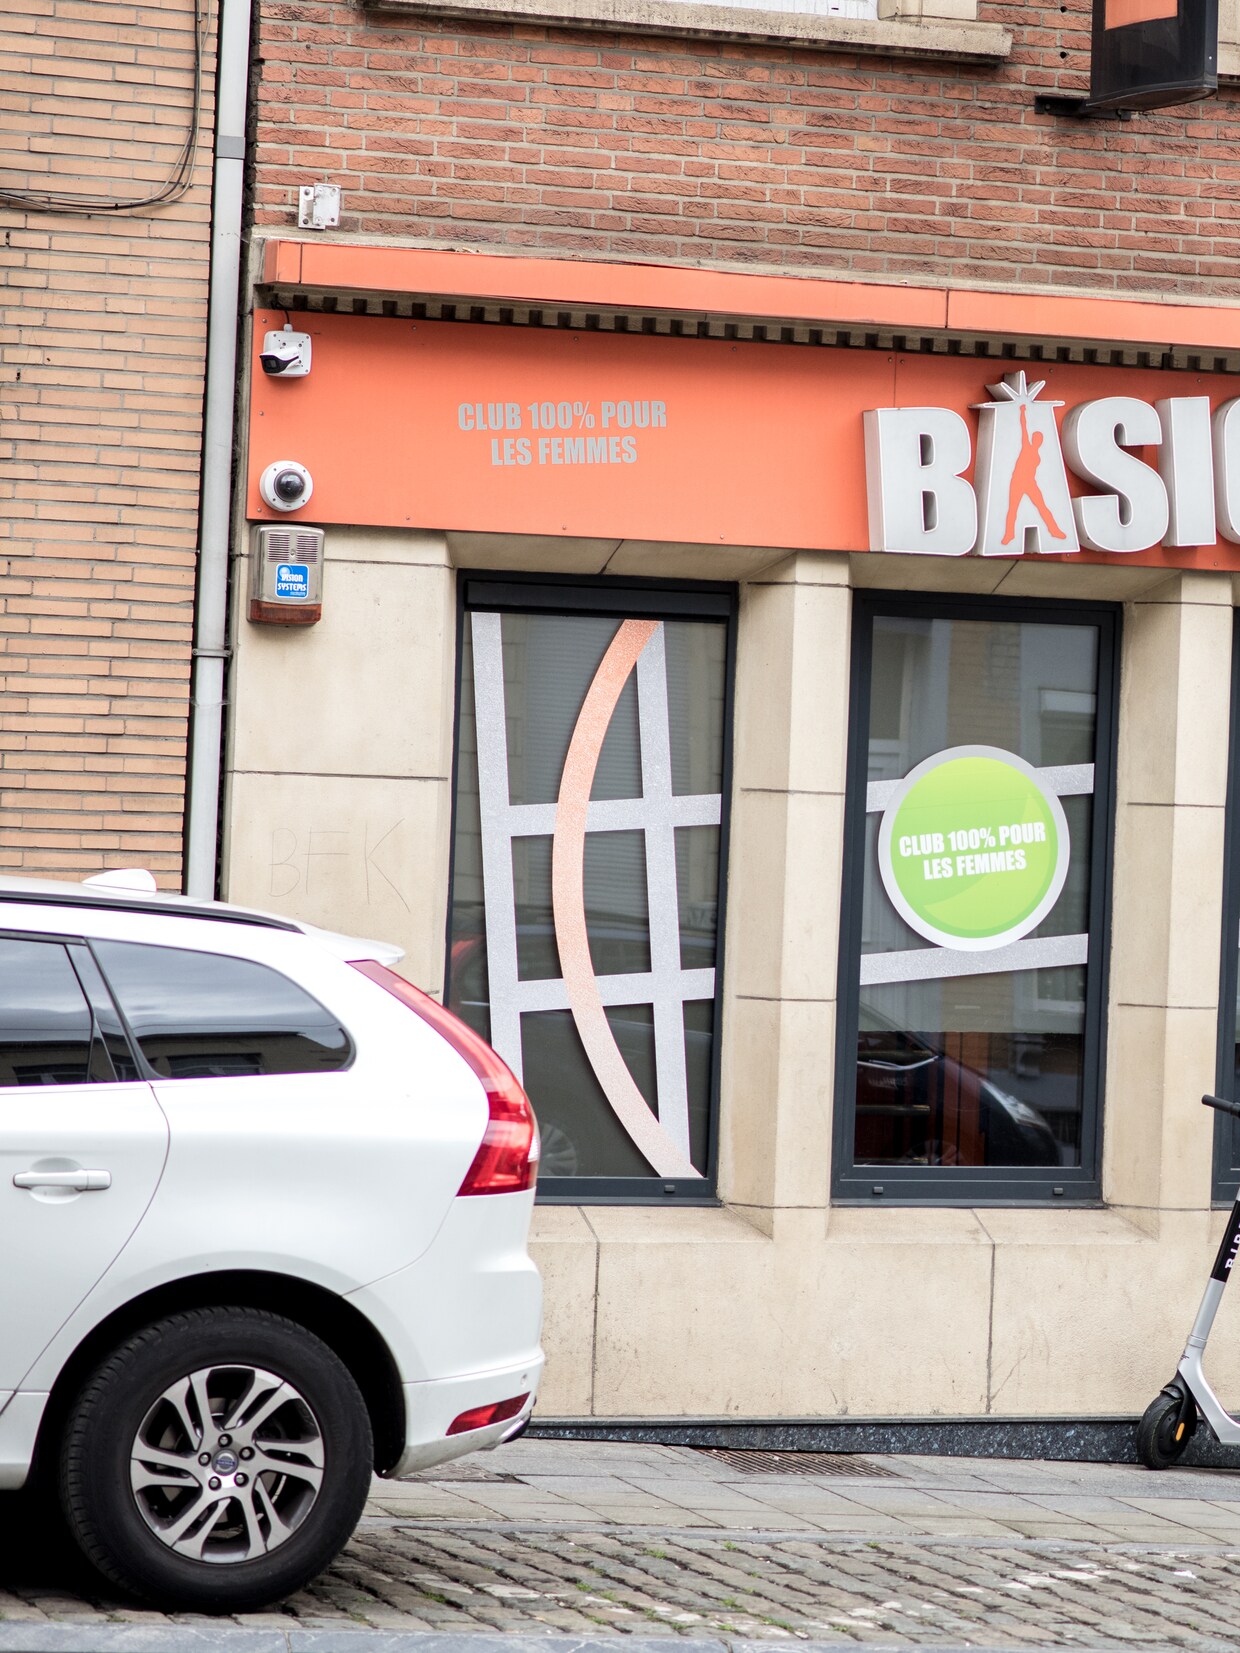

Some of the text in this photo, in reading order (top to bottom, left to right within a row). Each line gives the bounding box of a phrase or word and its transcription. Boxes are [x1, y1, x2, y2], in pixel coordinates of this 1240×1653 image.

[458, 400, 667, 430] CLUB 100% POUR
[491, 435, 637, 465] LES FEMMES
[899, 822, 1046, 857] CLUB 100% POUR
[923, 849, 1027, 880] LES FEMMES
